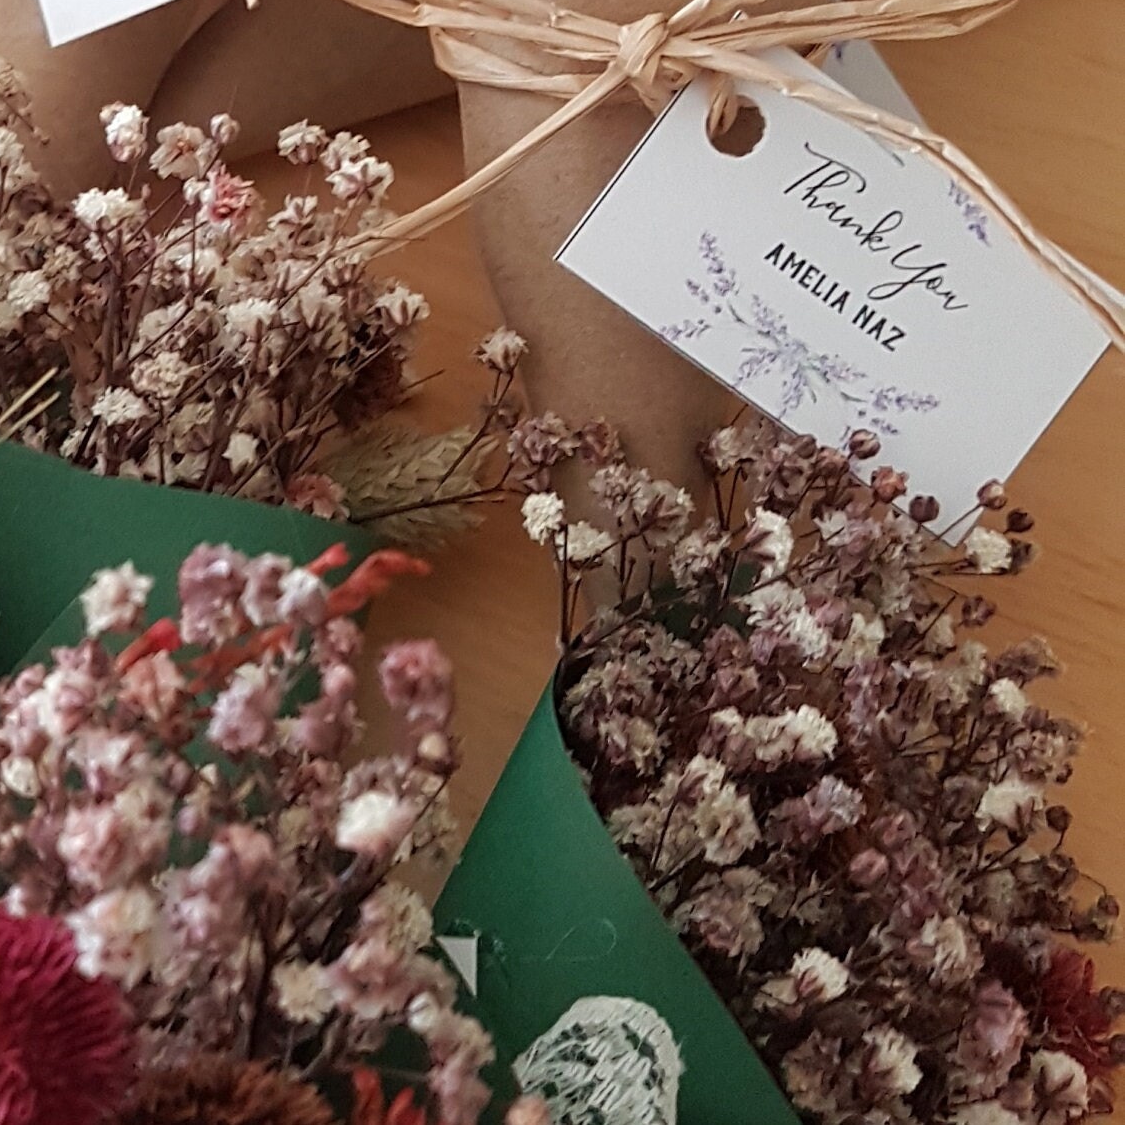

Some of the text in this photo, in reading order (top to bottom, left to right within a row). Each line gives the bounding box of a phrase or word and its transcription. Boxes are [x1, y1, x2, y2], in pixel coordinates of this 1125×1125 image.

[784, 141, 968, 310] Thank You
[763, 242, 907, 352] AMELIA NAZ
